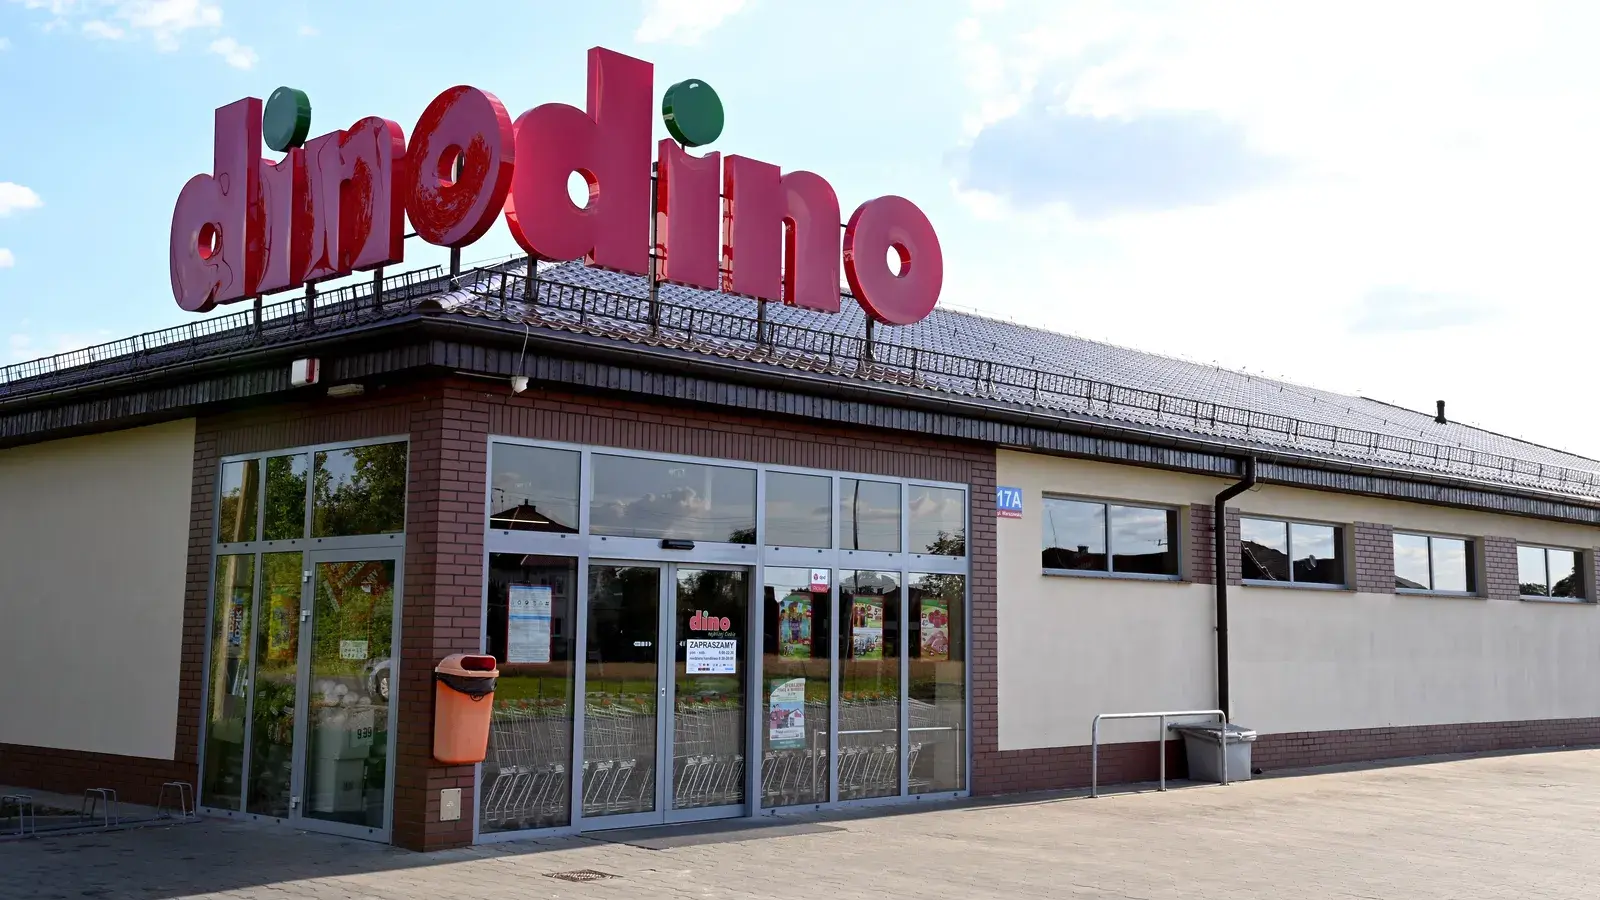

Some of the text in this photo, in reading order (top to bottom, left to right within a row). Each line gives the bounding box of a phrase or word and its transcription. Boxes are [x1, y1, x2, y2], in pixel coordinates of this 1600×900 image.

[504, 47, 943, 325] dino
[170, 84, 514, 312] dino
[997, 490, 1022, 508] 17A
[690, 610, 730, 631] dino
[690, 641, 734, 649] ZAPRASZAMY
